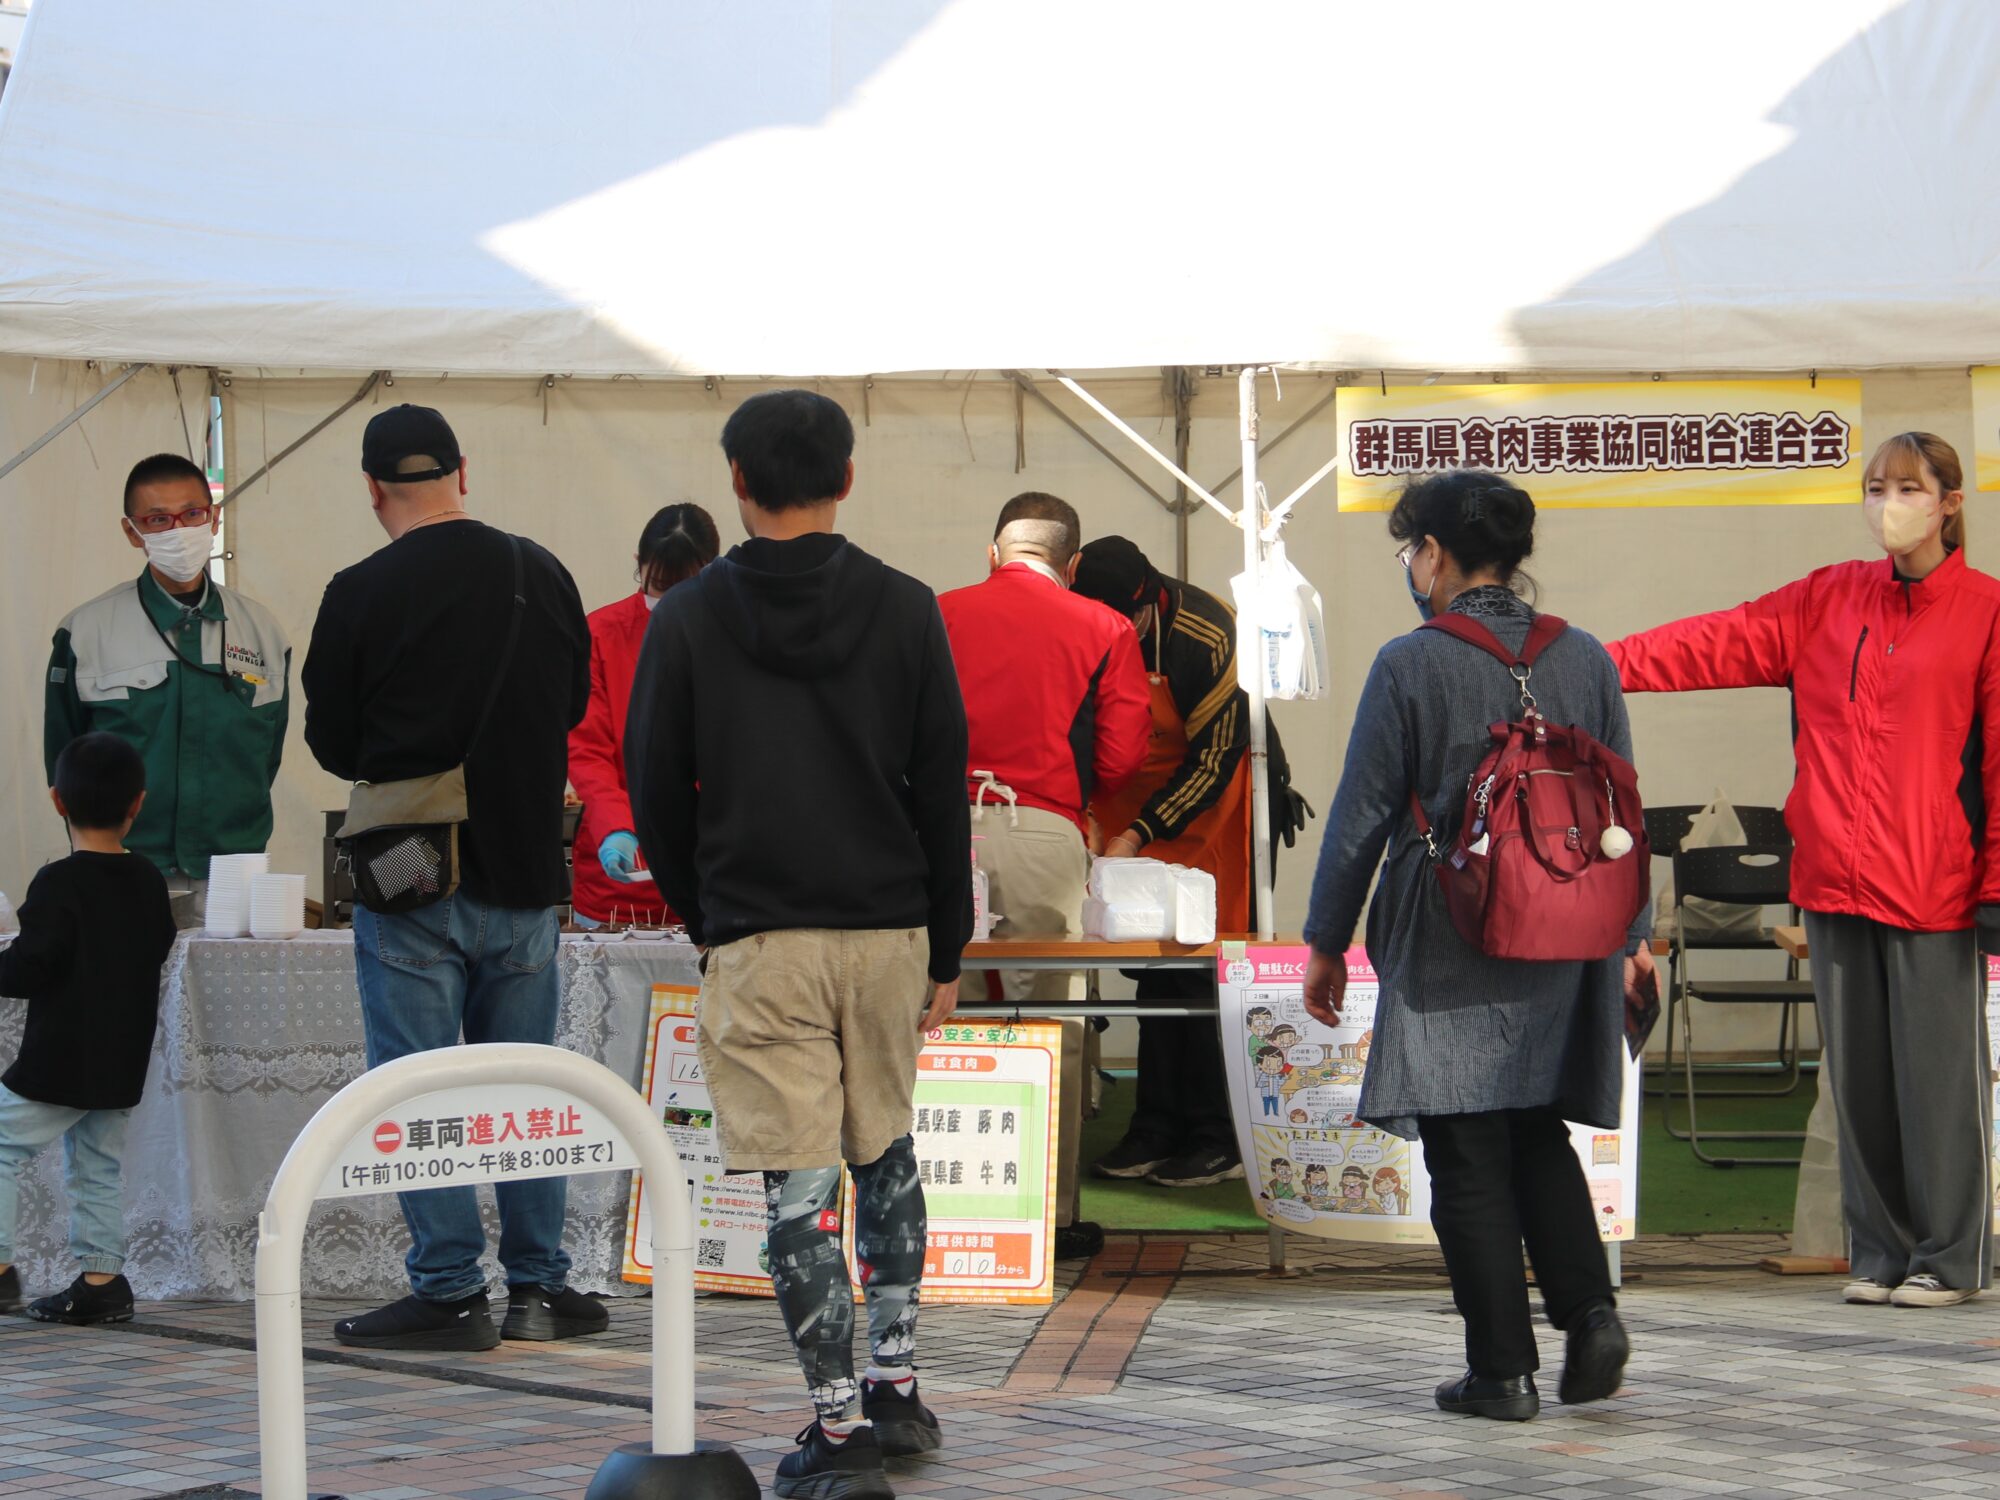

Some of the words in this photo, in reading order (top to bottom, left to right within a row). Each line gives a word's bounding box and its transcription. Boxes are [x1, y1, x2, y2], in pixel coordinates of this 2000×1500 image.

[1355, 415, 1845, 471] 群馬県食肉事業協同組合連合会
[927, 1027, 1018, 1043] の安全・安心
[678, 1063, 699, 1079] 16
[932, 1056, 978, 1070] 試食肉
[406, 1105, 584, 1151] 車両進入禁止
[912, 1108, 961, 1133] 馬県産
[996, 1264, 1025, 1275] 分から
